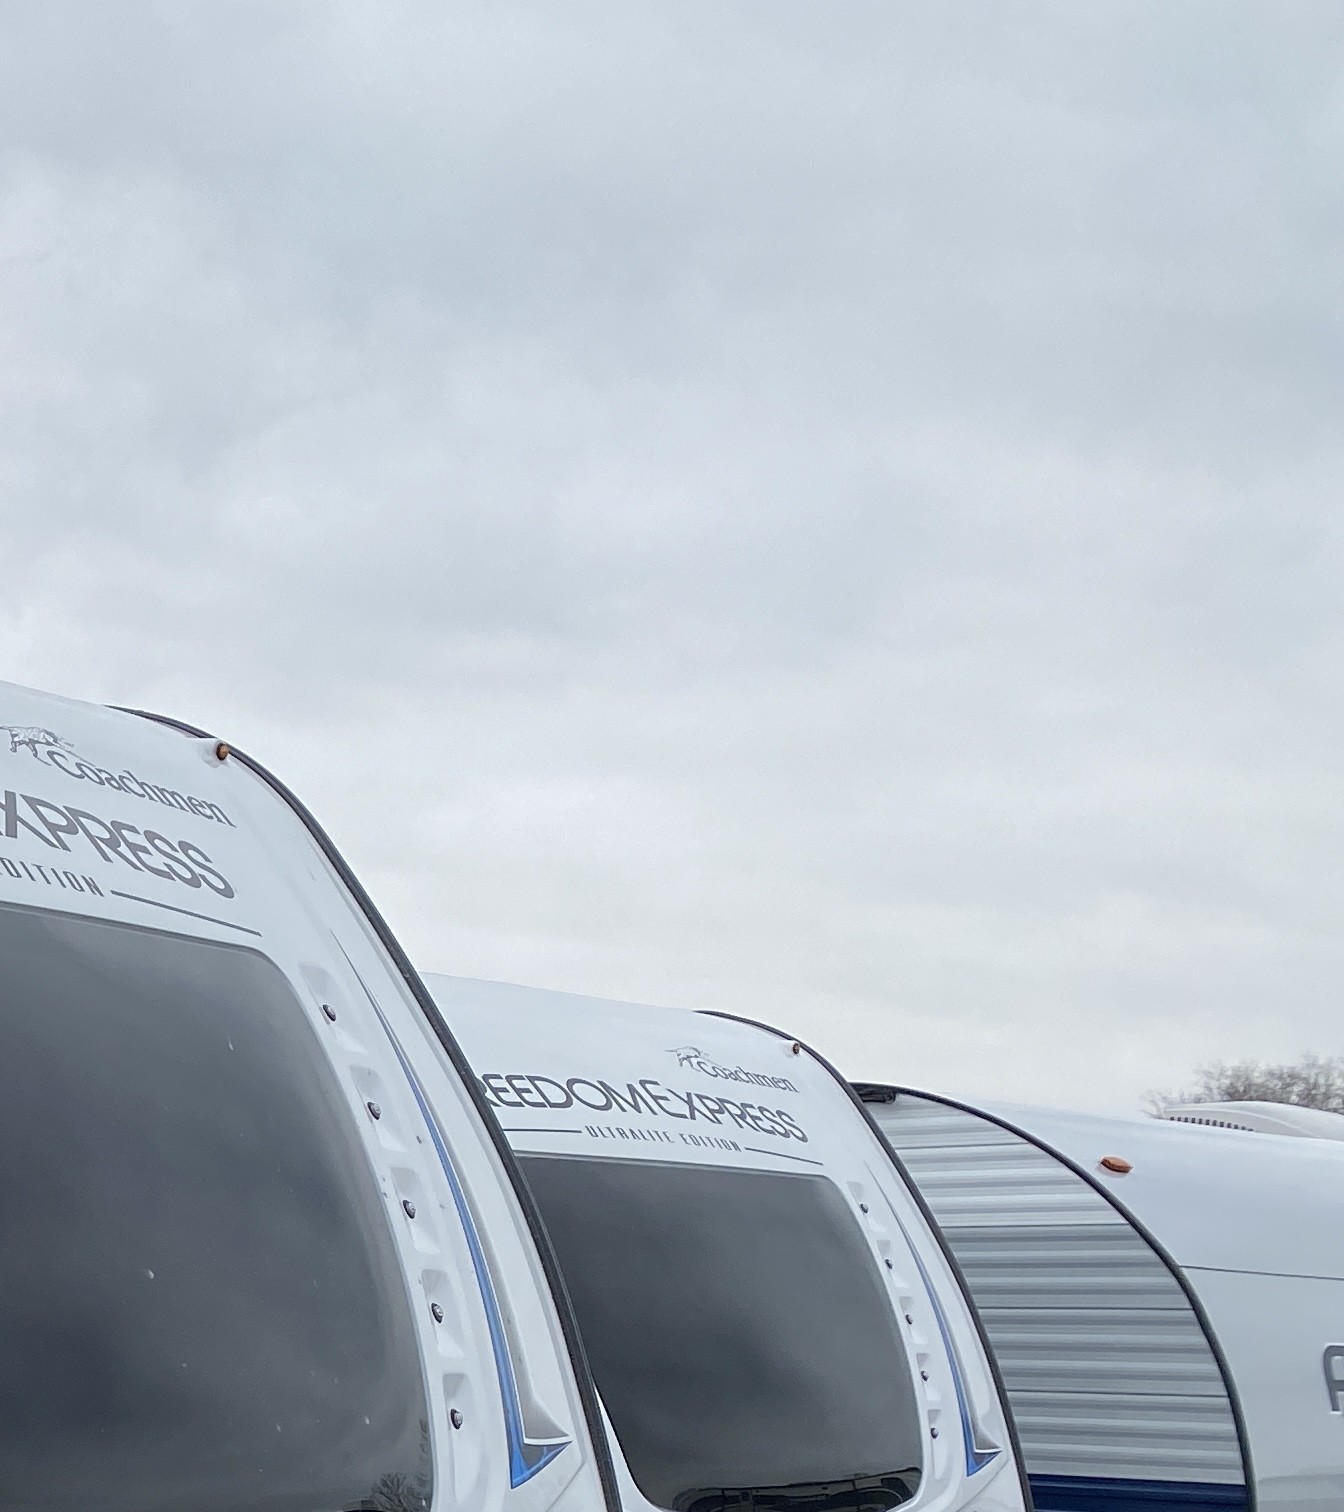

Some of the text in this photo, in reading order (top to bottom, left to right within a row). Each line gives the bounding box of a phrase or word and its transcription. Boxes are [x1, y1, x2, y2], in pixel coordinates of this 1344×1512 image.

[47, 750, 236, 827] Coachmen
[696, 1060, 801, 1094] Coachmen
[584, 1124, 743, 1153] ULTRALITE EDITION
